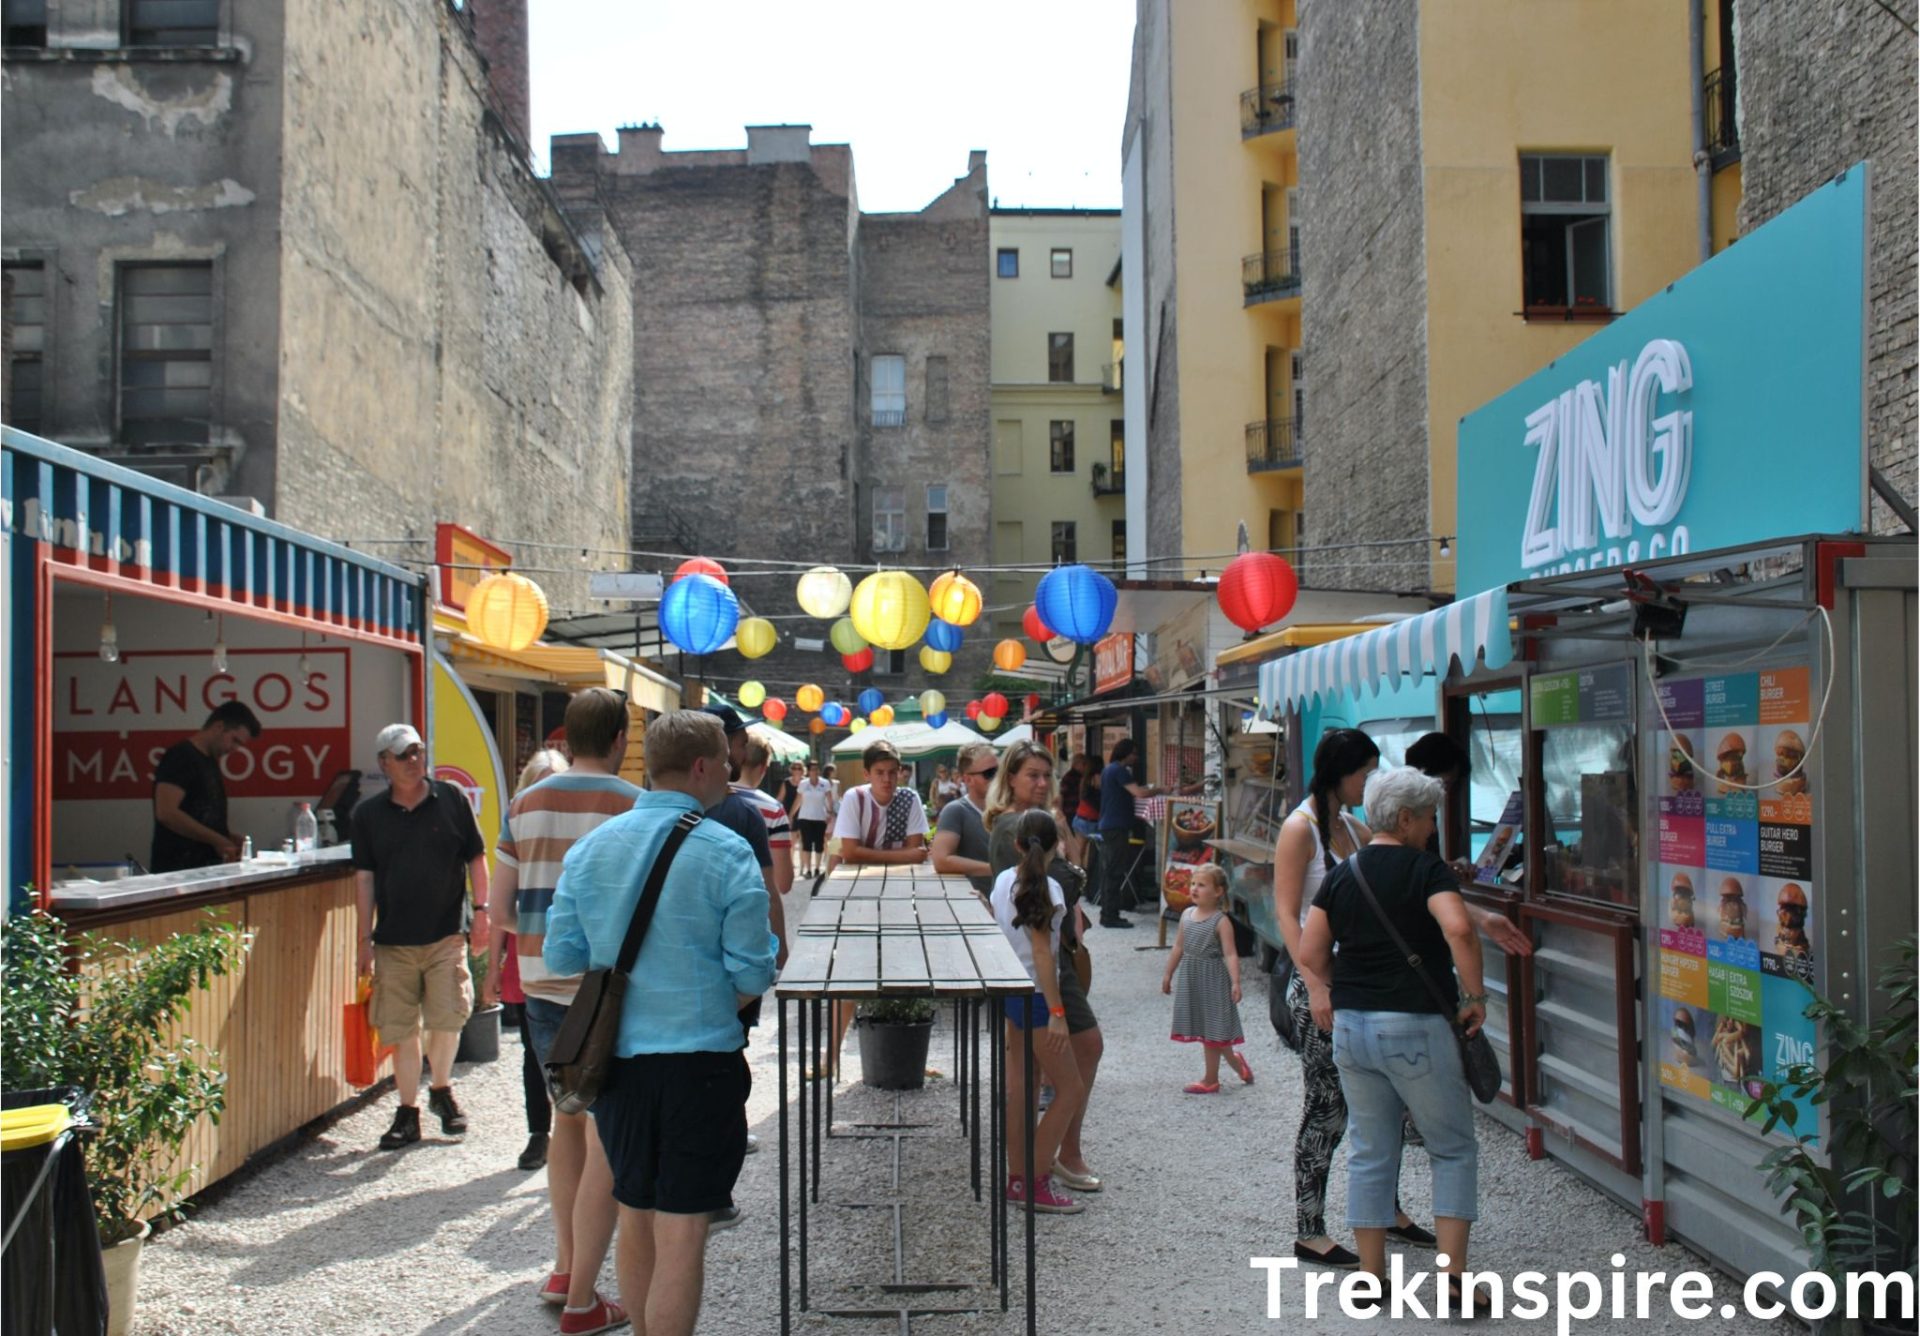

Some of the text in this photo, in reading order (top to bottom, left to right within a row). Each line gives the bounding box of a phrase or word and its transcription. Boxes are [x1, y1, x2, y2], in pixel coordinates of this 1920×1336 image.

[1521, 338, 1693, 569] ZING
[1705, 692, 1726, 704] BURGER
[1760, 687, 1784, 700] BURGER
[67, 730, 331, 783] MÁSOGY
[1706, 822, 1736, 835] FULL EXTRA
[1760, 827, 1799, 841] GUITAR HERO
[1659, 831, 1678, 842] BURGER
[1706, 835, 1727, 848] BURGER
[1760, 840, 1784, 853] BURGER
[1775, 1033, 1814, 1066] ZING
